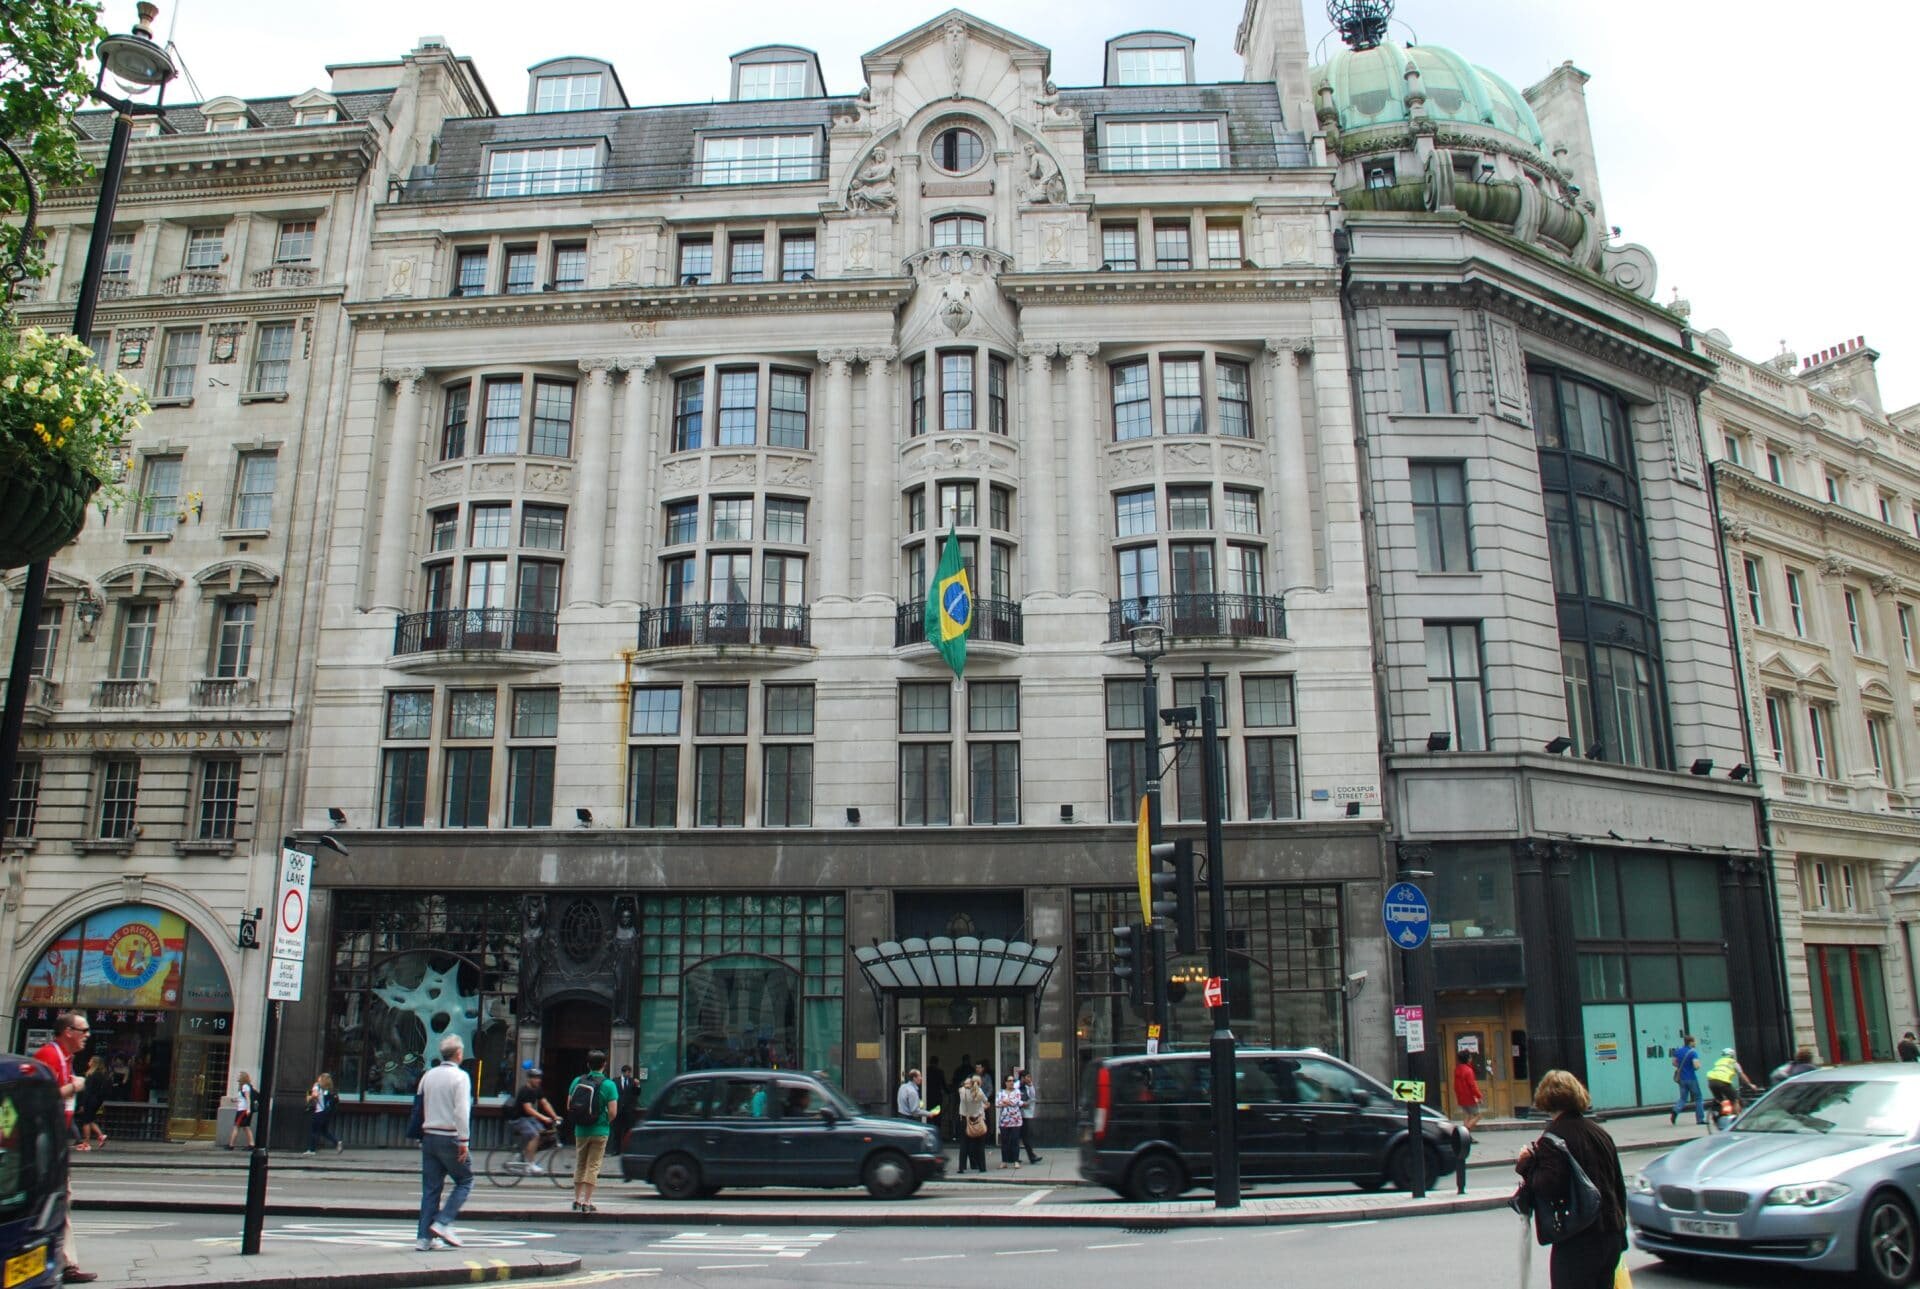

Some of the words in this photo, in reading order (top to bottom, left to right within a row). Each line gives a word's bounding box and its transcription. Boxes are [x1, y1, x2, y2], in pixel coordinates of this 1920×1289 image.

[286, 870, 305, 886] LANE
[105, 933, 121, 951] THE
[122, 926, 160, 953] ORIGINAL
[190, 1017, 203, 1028] 17
[213, 1017, 226, 1029] 19
